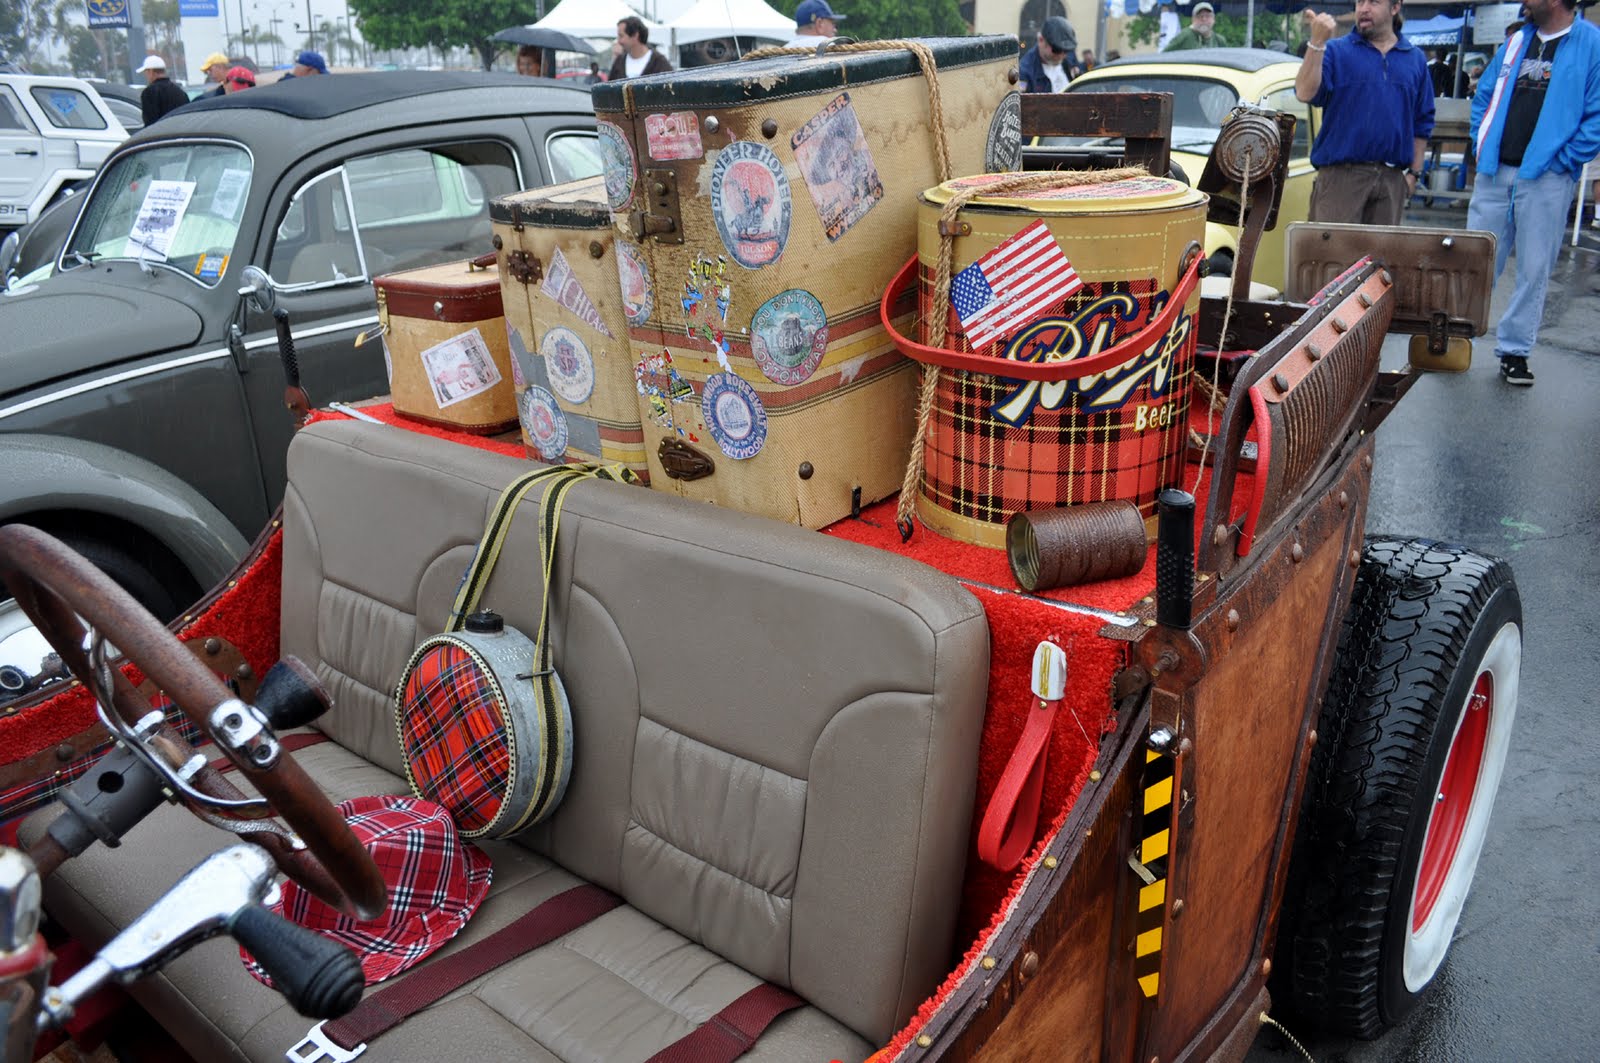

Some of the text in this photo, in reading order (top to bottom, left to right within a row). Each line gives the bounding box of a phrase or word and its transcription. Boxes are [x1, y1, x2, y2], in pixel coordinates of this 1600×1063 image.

[90, 16, 127, 24] SUBARU
[792, 95, 849, 146] CASPER
[711, 141, 792, 211] PIONEER HOTEL
[562, 277, 610, 337] CHICAGO
[778, 331, 803, 349] BEANS
[702, 373, 767, 432] HOLLYWOOD ROOSEVELT
[1134, 403, 1176, 432] Beer
[717, 436, 763, 458] HOLLYWOOD
